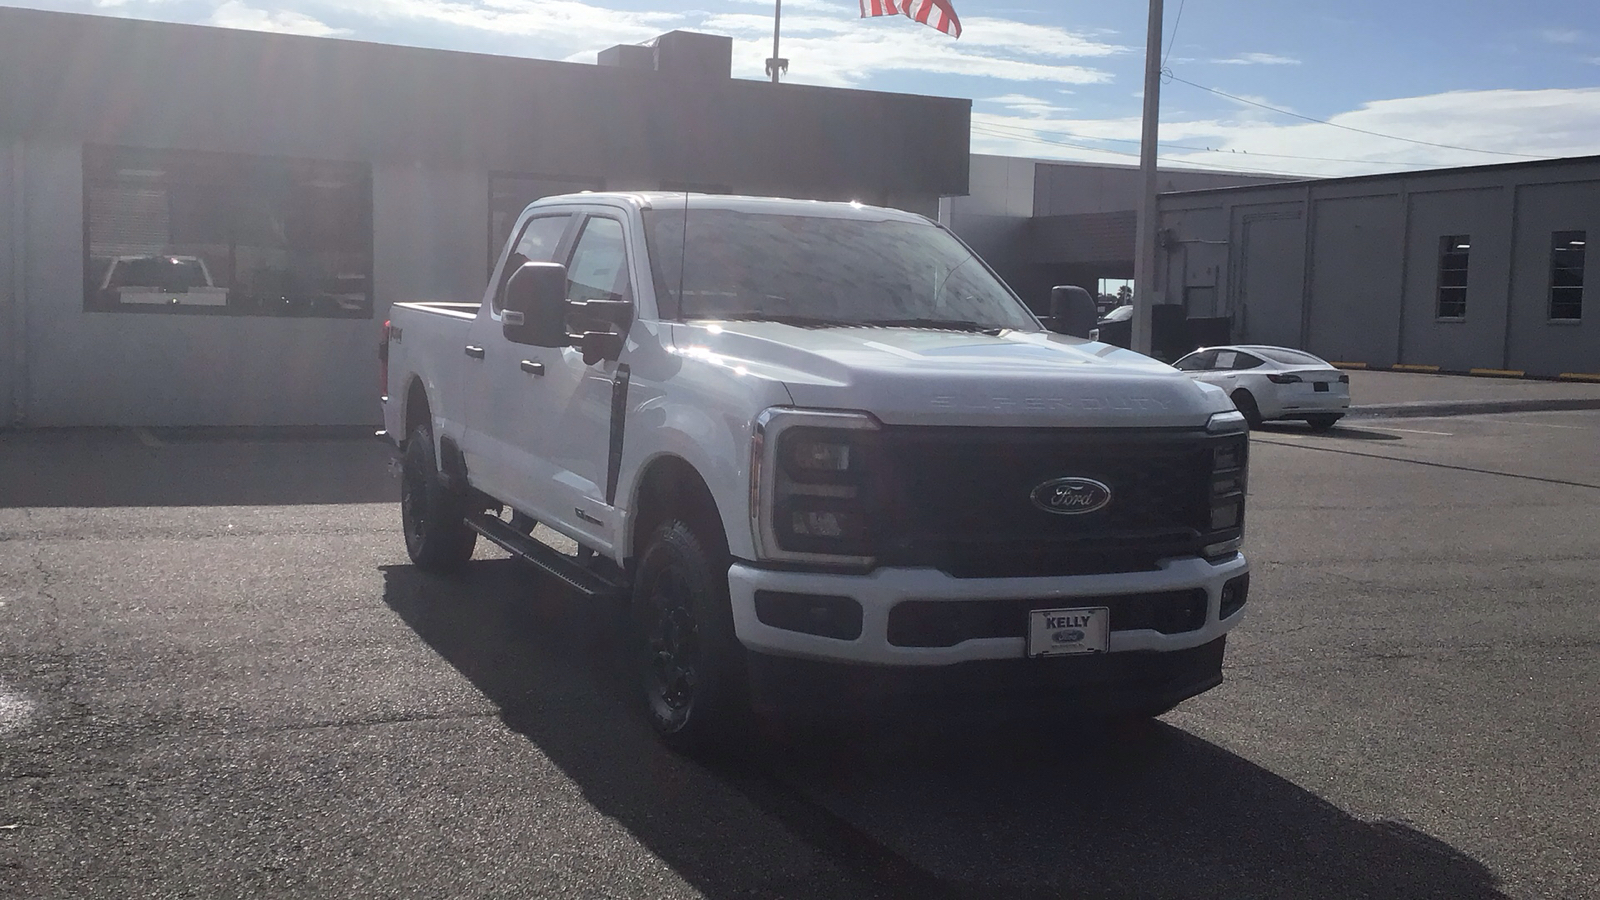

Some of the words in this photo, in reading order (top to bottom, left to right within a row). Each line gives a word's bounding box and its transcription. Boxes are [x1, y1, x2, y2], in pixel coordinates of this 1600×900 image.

[1080, 397, 1171, 410] DUTY
[1051, 485, 1095, 506] Ford
[1046, 615, 1091, 630] KELLY
